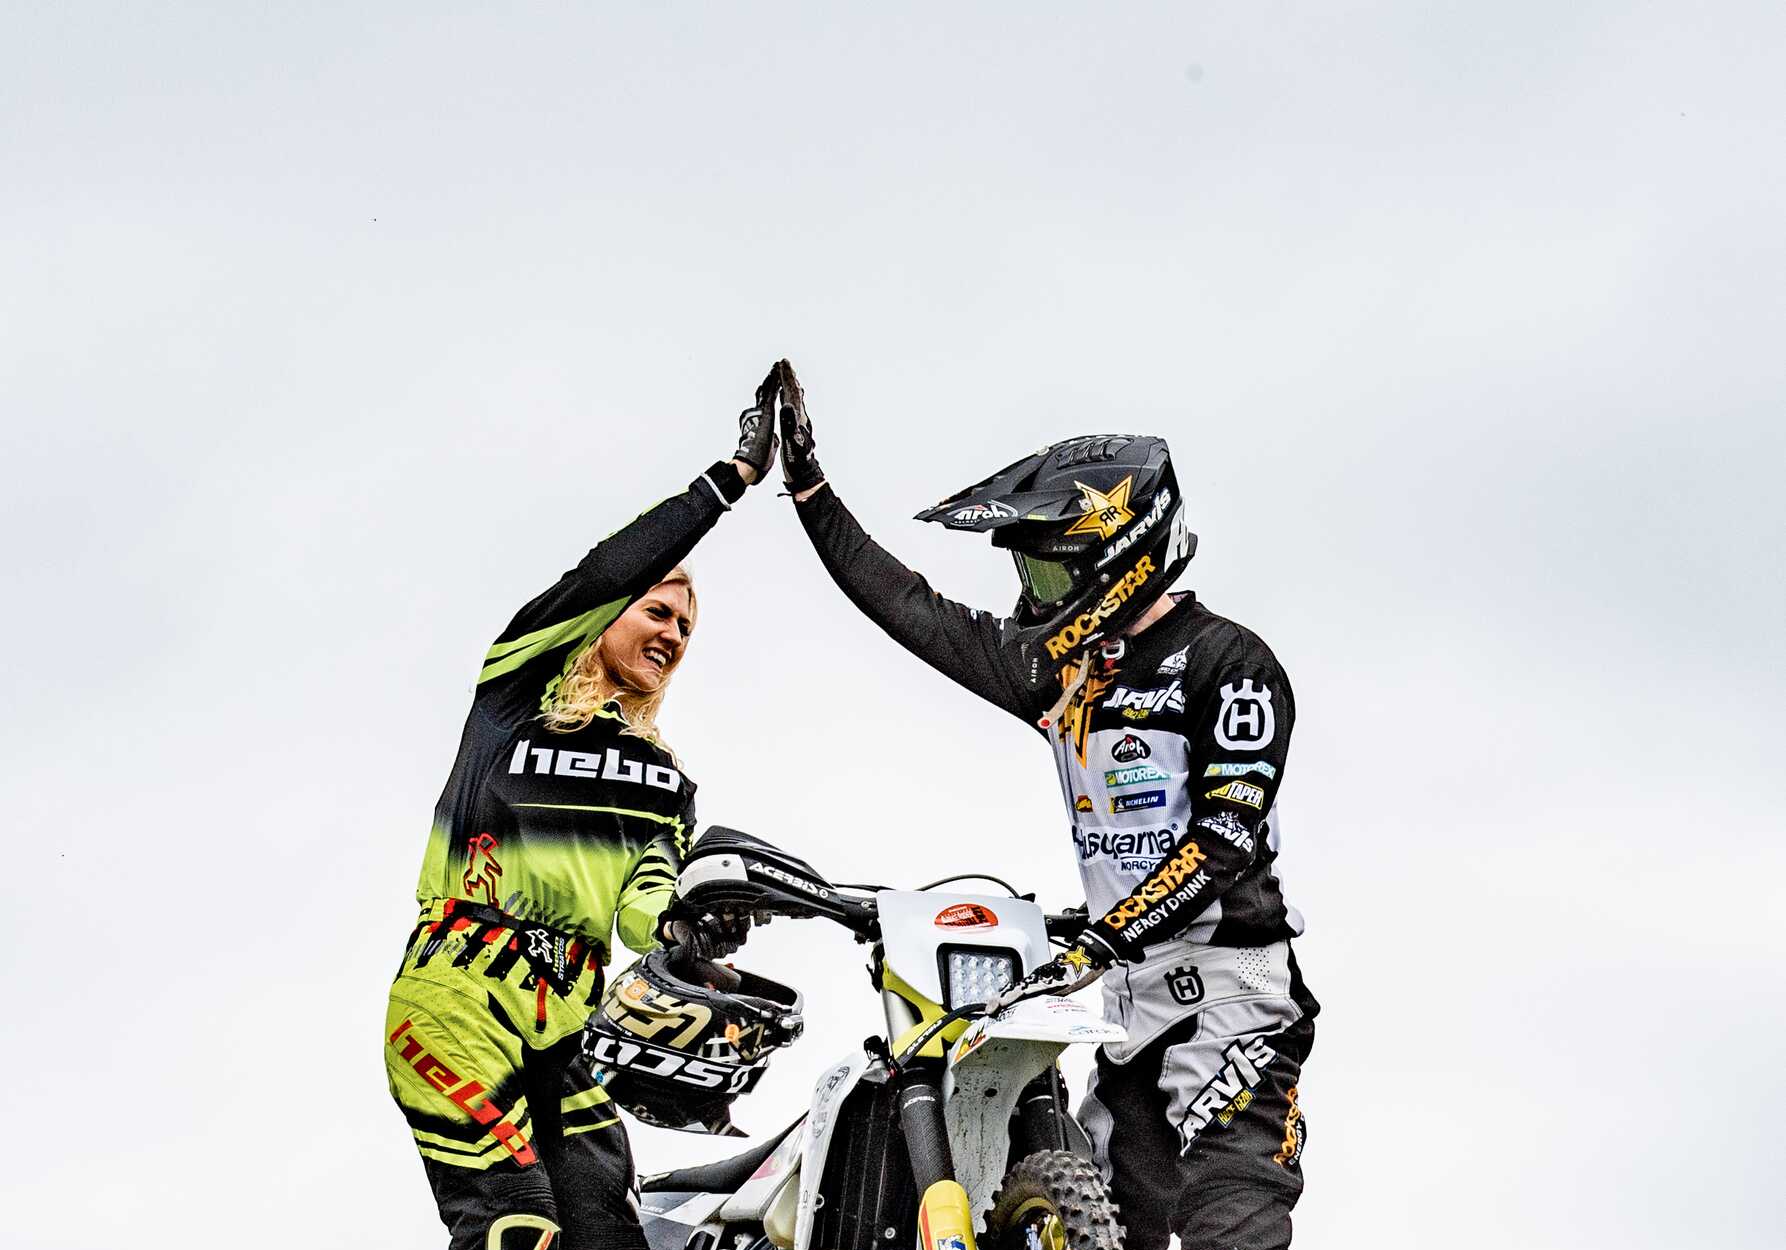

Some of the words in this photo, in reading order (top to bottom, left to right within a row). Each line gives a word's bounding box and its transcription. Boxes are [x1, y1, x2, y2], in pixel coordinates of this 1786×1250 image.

[1095, 487, 1172, 569] JARVIS
[1044, 555, 1156, 660] ROCKSTAR
[1030, 656, 1039, 684] AIROH
[509, 739, 681, 793] hebo
[1227, 783, 1263, 807] TAPER
[749, 861, 819, 894] ACERBIS
[1104, 842, 1207, 930] OCKSTAR
[1120, 904, 1168, 942] NERGY
[1166, 869, 1211, 911] DRINK
